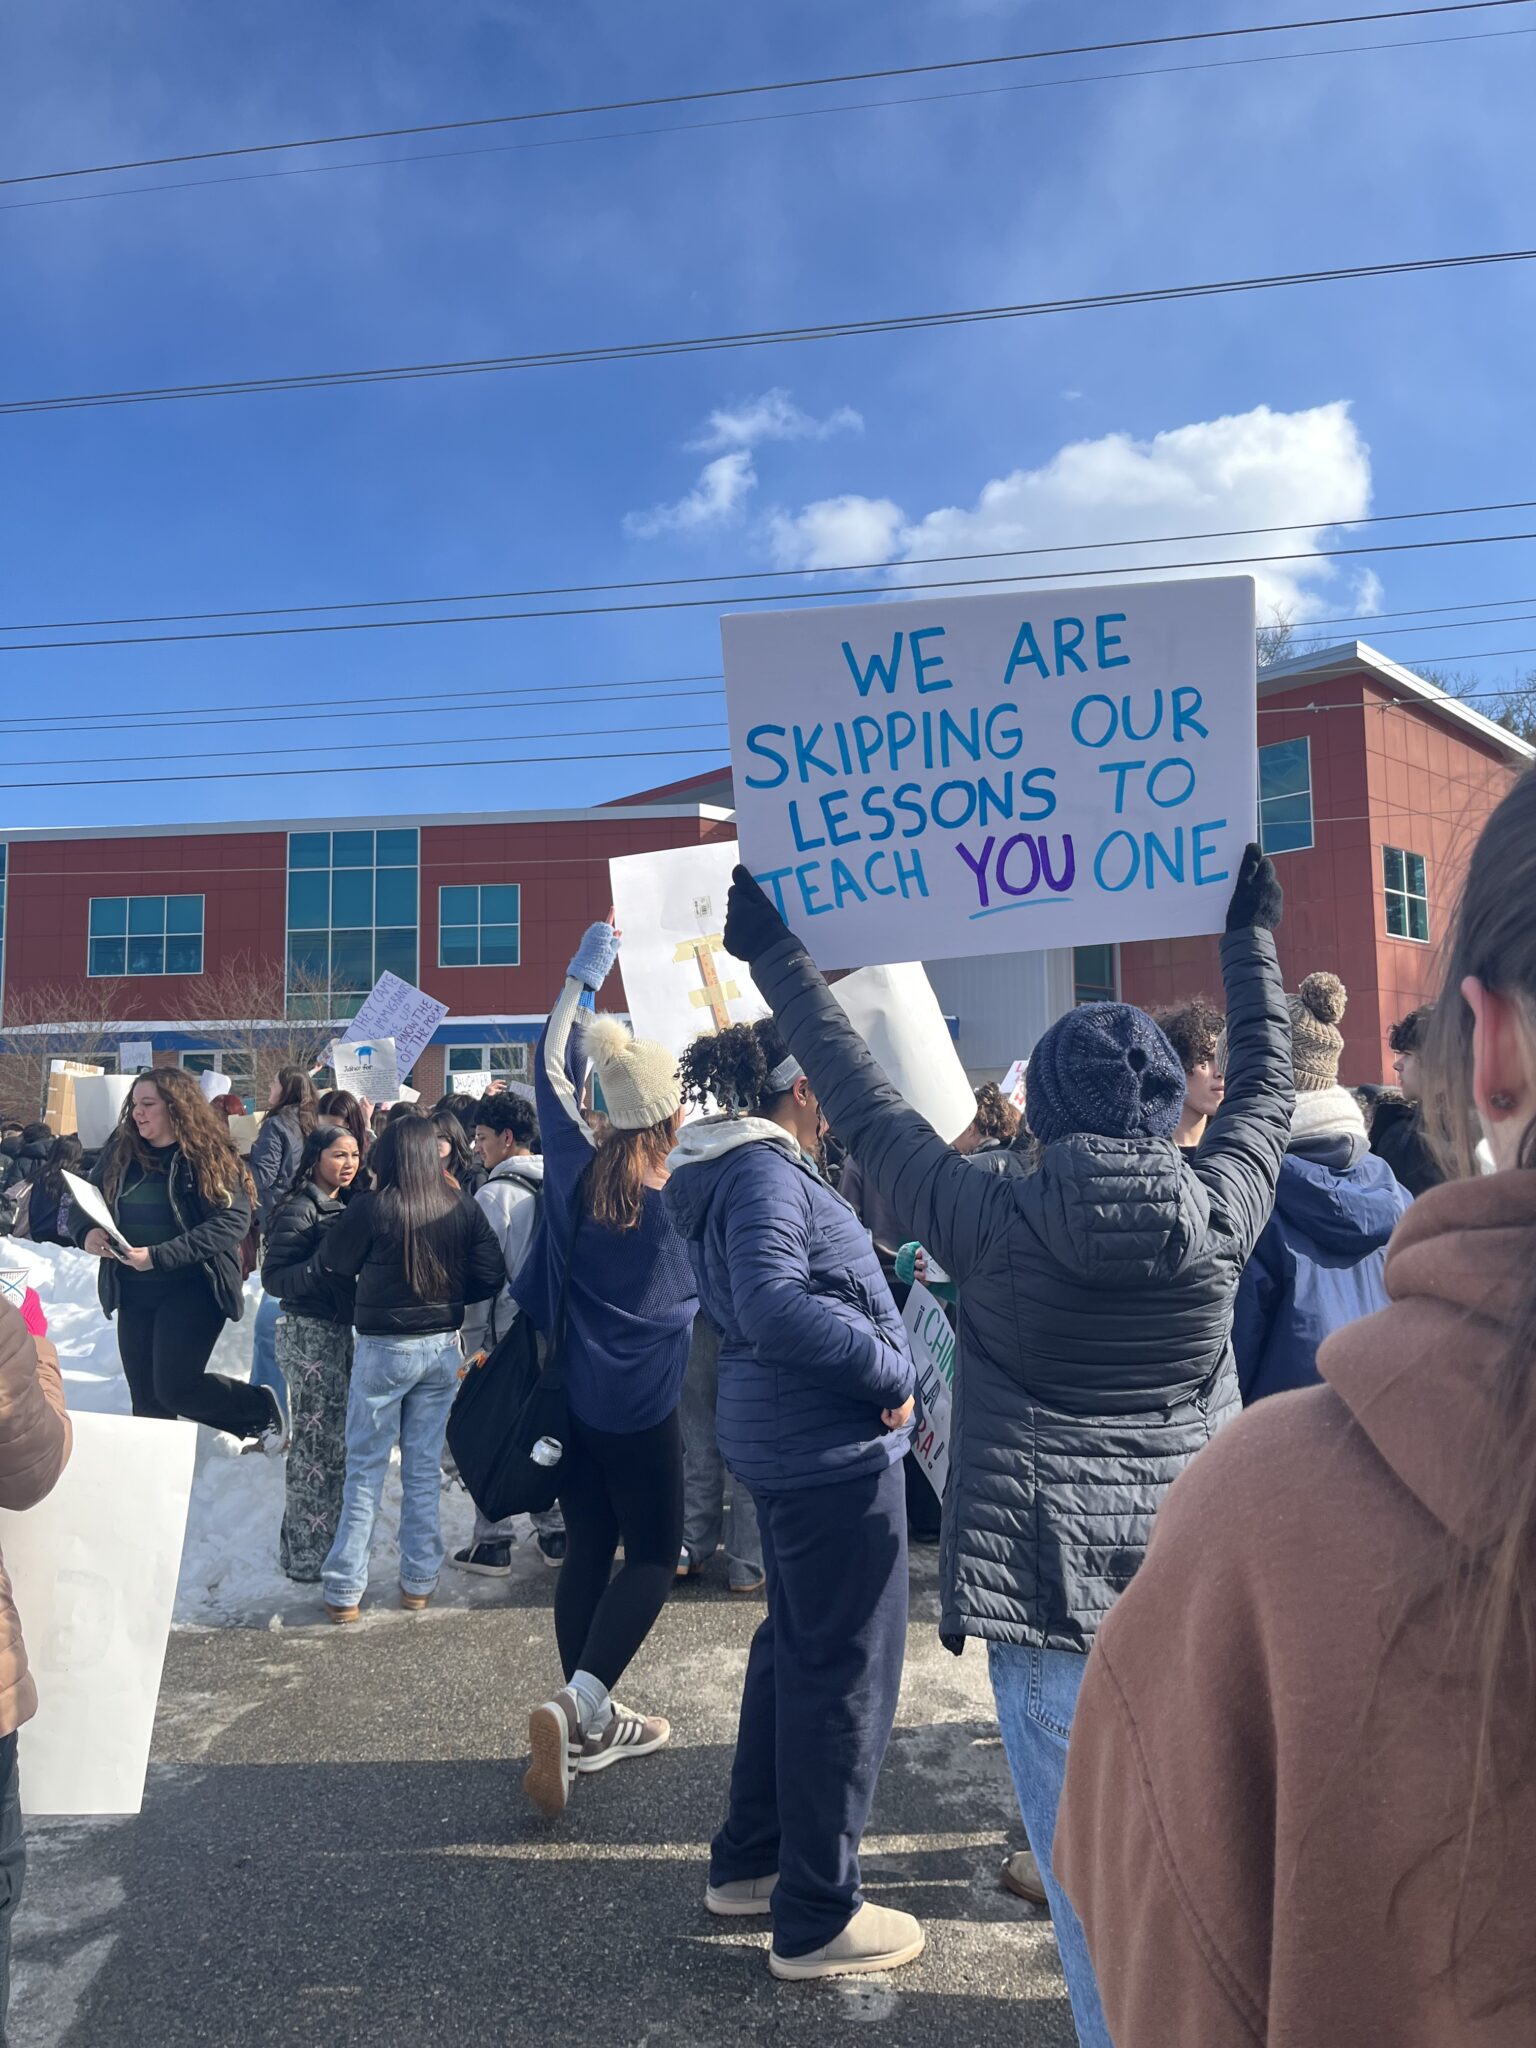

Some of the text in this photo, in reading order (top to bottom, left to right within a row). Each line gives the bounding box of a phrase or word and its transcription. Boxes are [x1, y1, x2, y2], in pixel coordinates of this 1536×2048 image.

[841, 613, 1131, 697] WE ARE
[745, 687, 1209, 790] SKIPPING OUR
[788, 757, 1196, 852] LESSONS TO
[753, 819, 1229, 926] TEACH YOU ONE
[352, 974, 398, 1031] THEY CAME
[397, 1018, 419, 1044] KNOW
[412, 999, 433, 1019] THE
[400, 1003, 411, 1020] UP
[400, 1045, 414, 1062] OF
[409, 1027, 430, 1047] THE
[919, 1364, 941, 1414] LA
